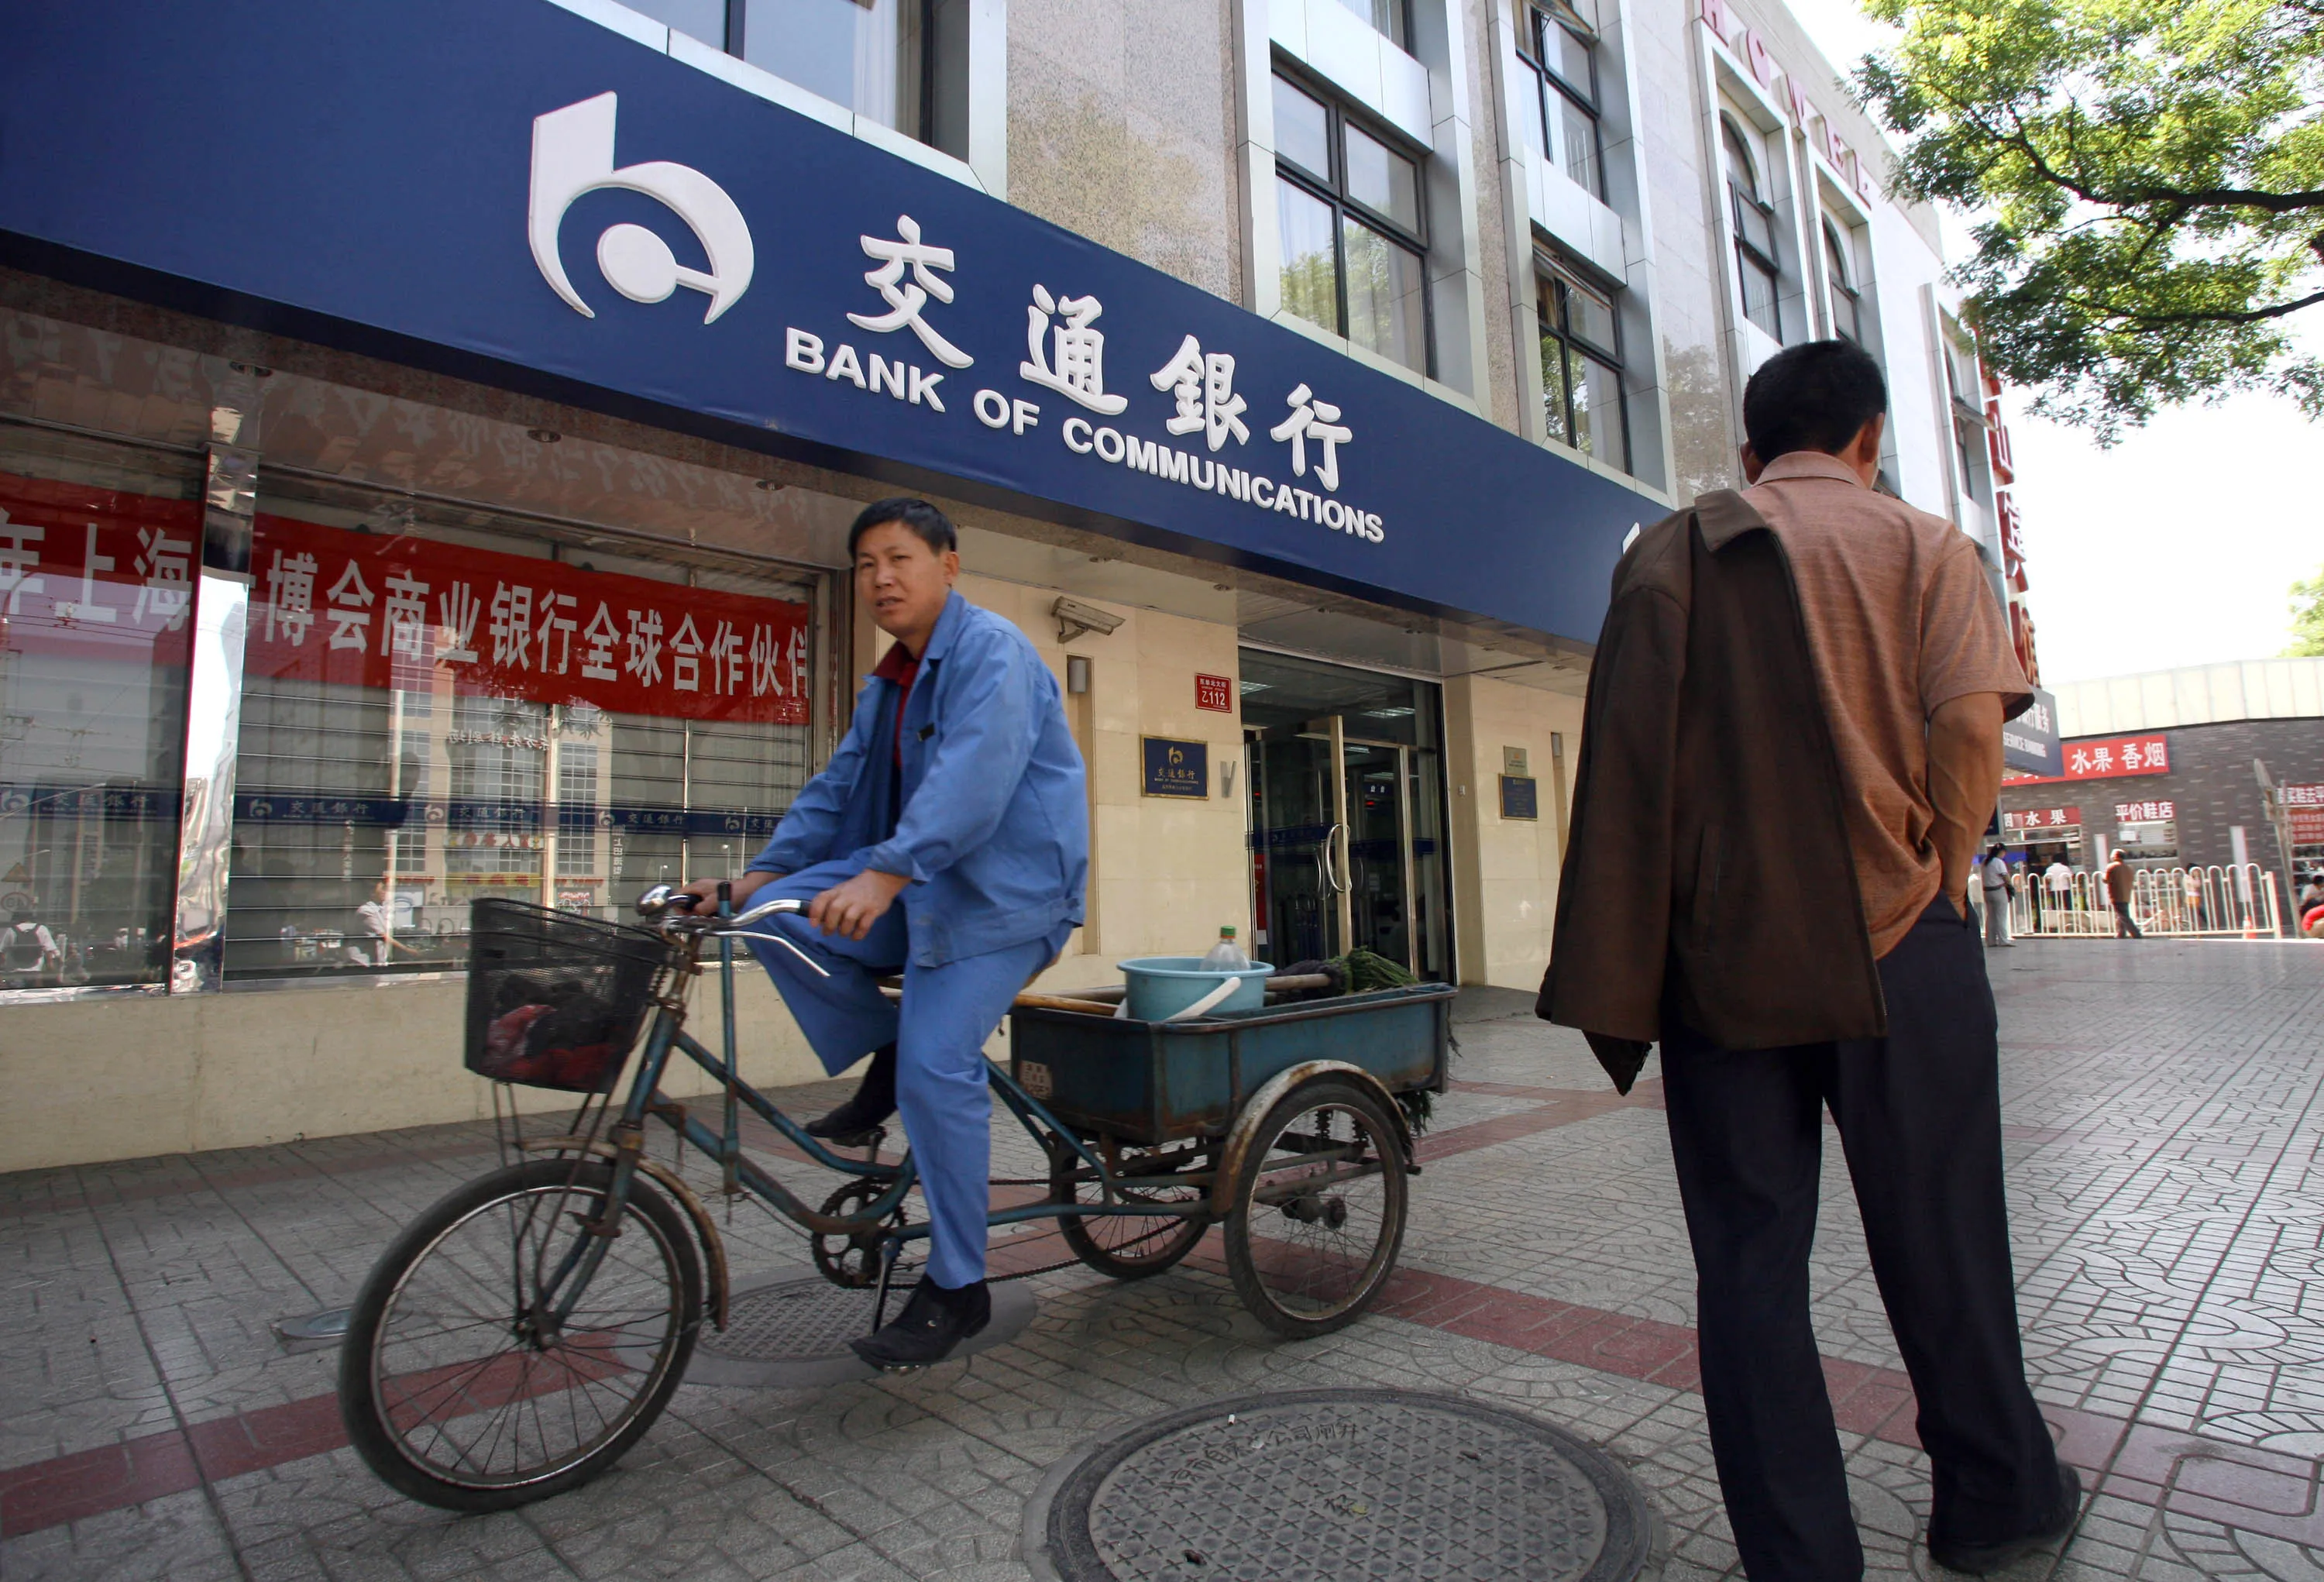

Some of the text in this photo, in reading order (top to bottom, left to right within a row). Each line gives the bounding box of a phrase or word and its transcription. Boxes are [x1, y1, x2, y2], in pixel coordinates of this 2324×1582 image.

[786, 327, 1384, 544] BANK OF COMMUNICATIONS
[847, 214, 1353, 493] 交通銀行
[0, 507, 809, 699] 年上海博会商业银行全球合作伙伴
[2071, 742, 2166, 775] 水果 香烟
[2115, 802, 2174, 821] 平价鞋店
